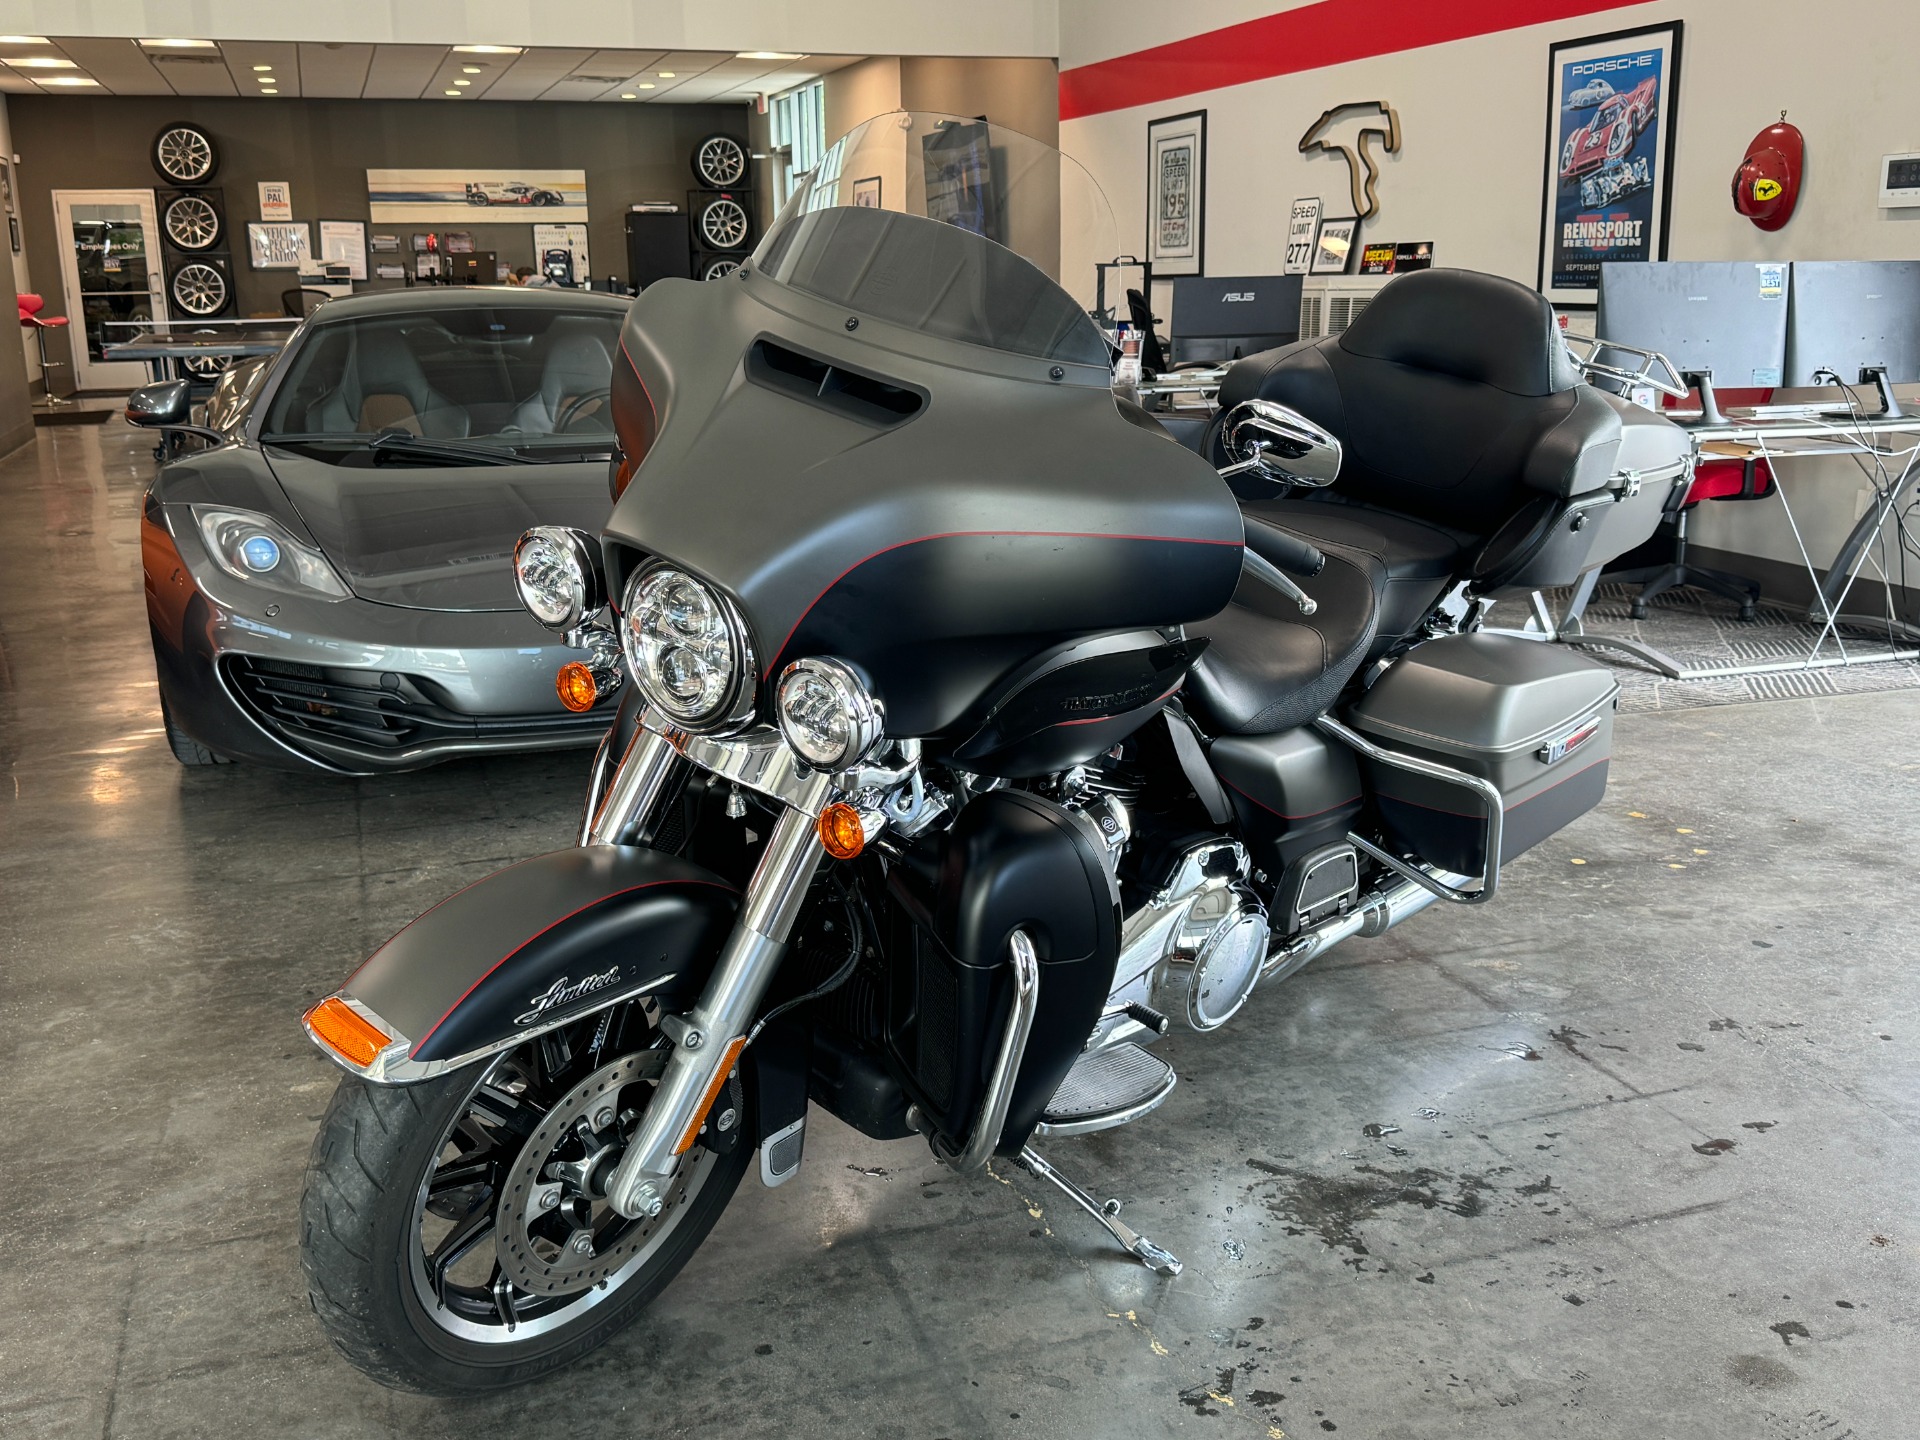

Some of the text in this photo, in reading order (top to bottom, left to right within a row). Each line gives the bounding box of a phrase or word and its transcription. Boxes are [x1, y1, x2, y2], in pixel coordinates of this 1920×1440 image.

[1572, 54, 1653, 76] PORSCHE
[1165, 166, 1186, 179] SPEED
[267, 193, 282, 203] PAL
[1164, 193, 1186, 217] 195
[1292, 205, 1317, 219] SPEED
[1292, 223, 1312, 235] LIMIT
[1563, 220, 1643, 239] RENNSPORT
[81, 243, 140, 251] Emploees Only
[1562, 238, 1642, 248] REUNION
[1287, 243, 1310, 264] 277
[1760, 278, 1780, 288] BEST
[1222, 292, 1255, 303] ASUS
